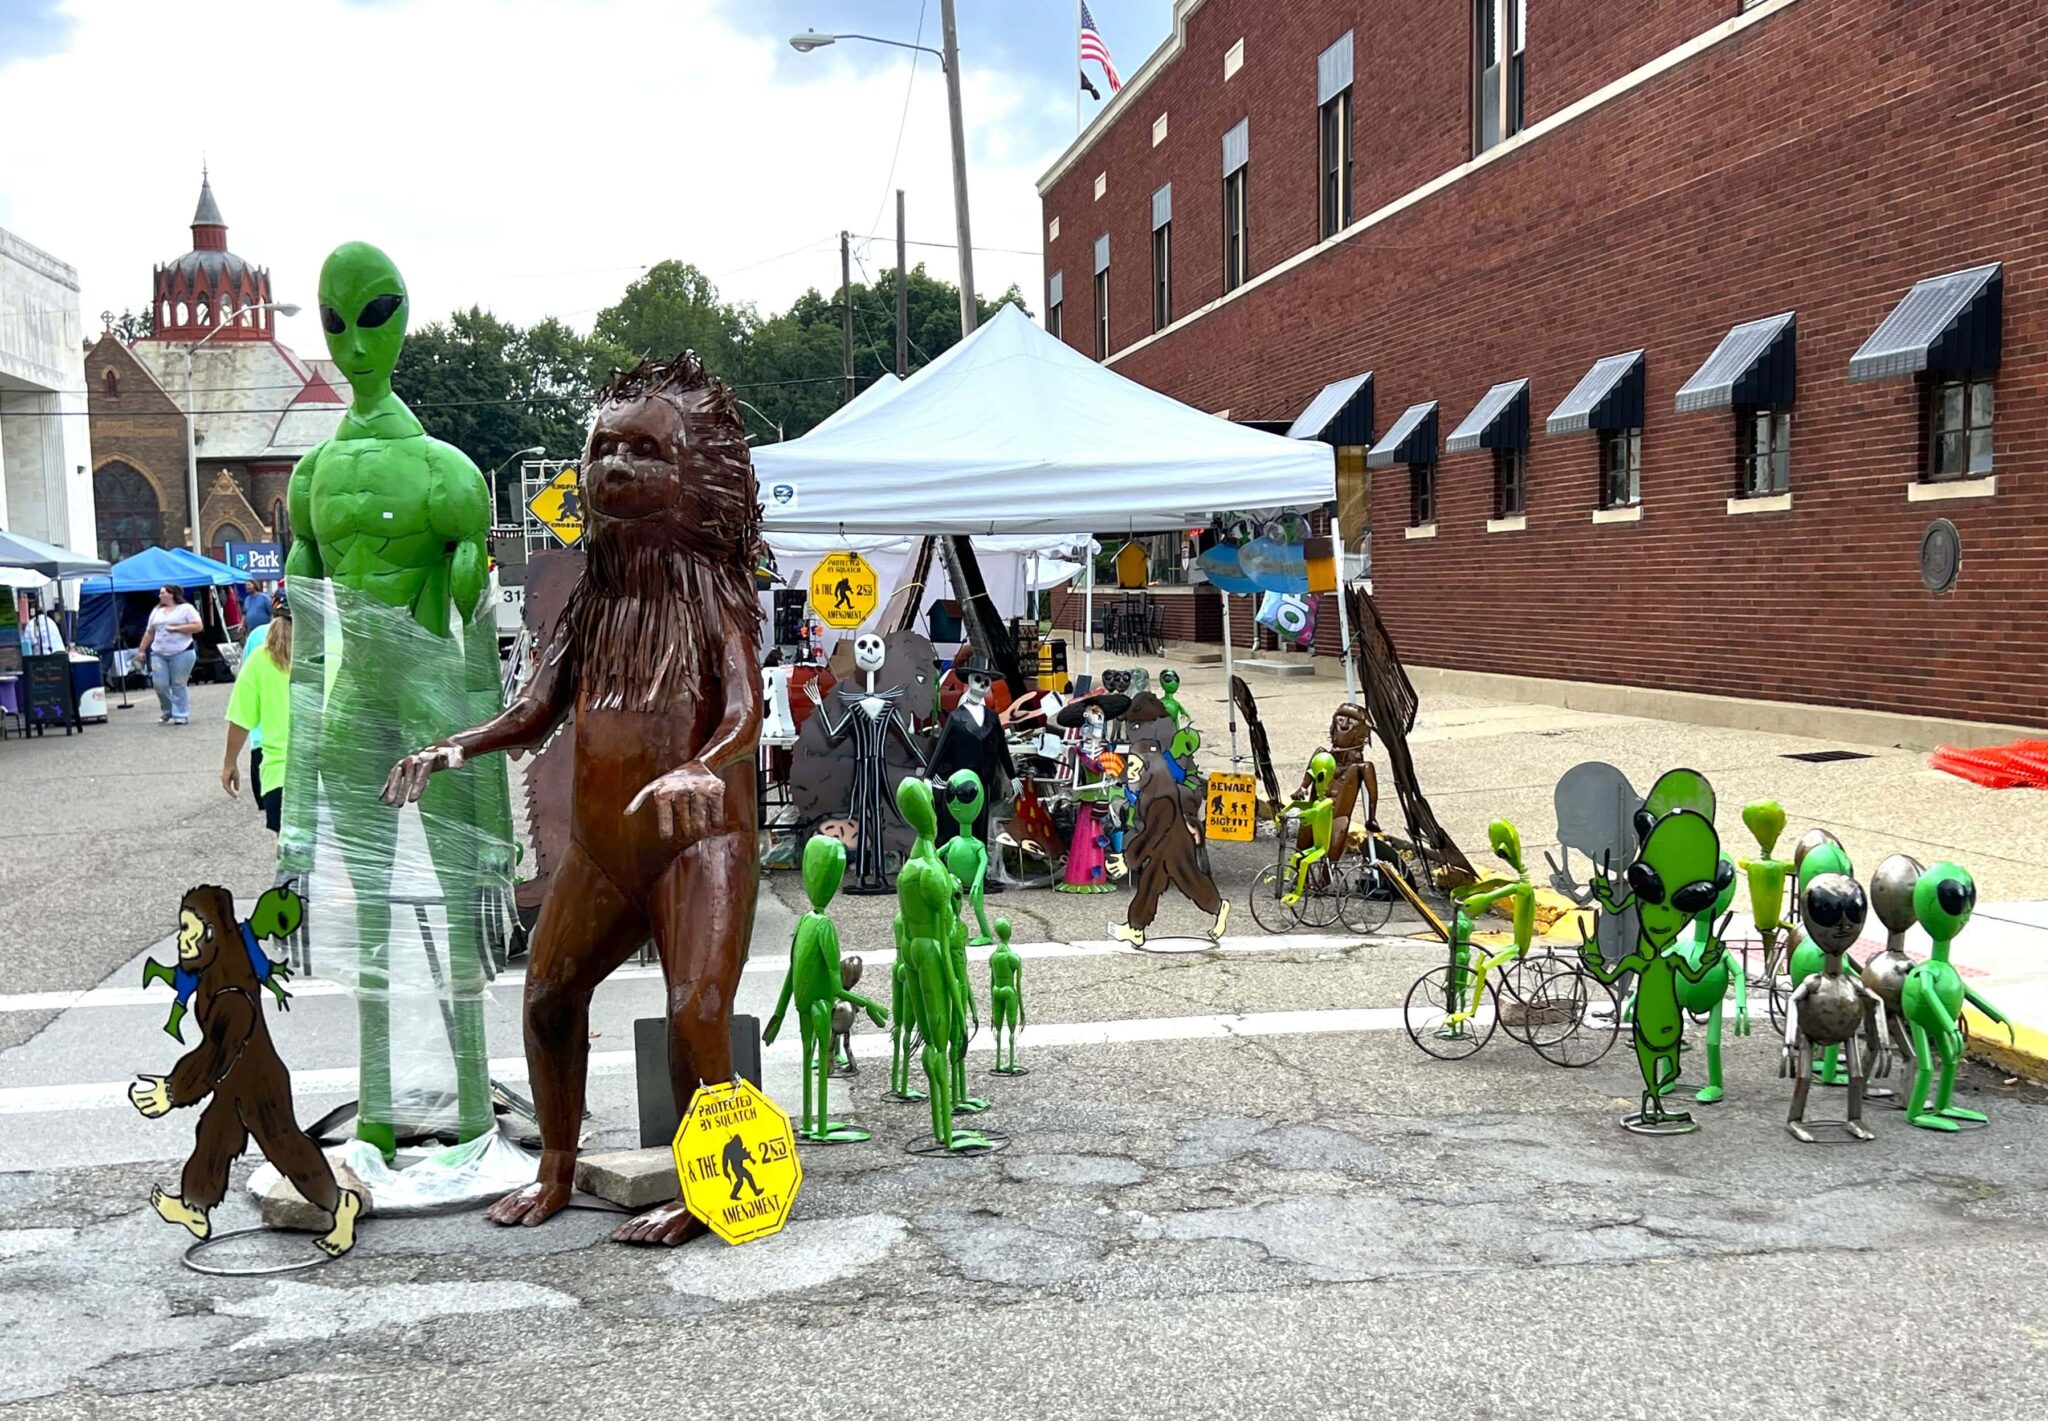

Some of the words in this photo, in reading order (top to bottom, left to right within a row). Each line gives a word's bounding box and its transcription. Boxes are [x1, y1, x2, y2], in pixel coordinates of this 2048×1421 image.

[249, 550, 280, 568] Park
[503, 590, 525, 603] 31
[821, 584, 833, 596] THE
[827, 610, 862, 619] AMENDMENT
[1277, 593, 1311, 632] OP
[1210, 782, 1253, 794] BEWARE
[698, 1095, 752, 1118] PROTECTED
[700, 1118, 712, 1131] BY
[715, 1107, 758, 1129] SQUATCH
[687, 1160, 697, 1183] &
[696, 1154, 720, 1181] THE
[758, 1137, 788, 1165] 2ND
[722, 1194, 780, 1225] AMENDMENT
